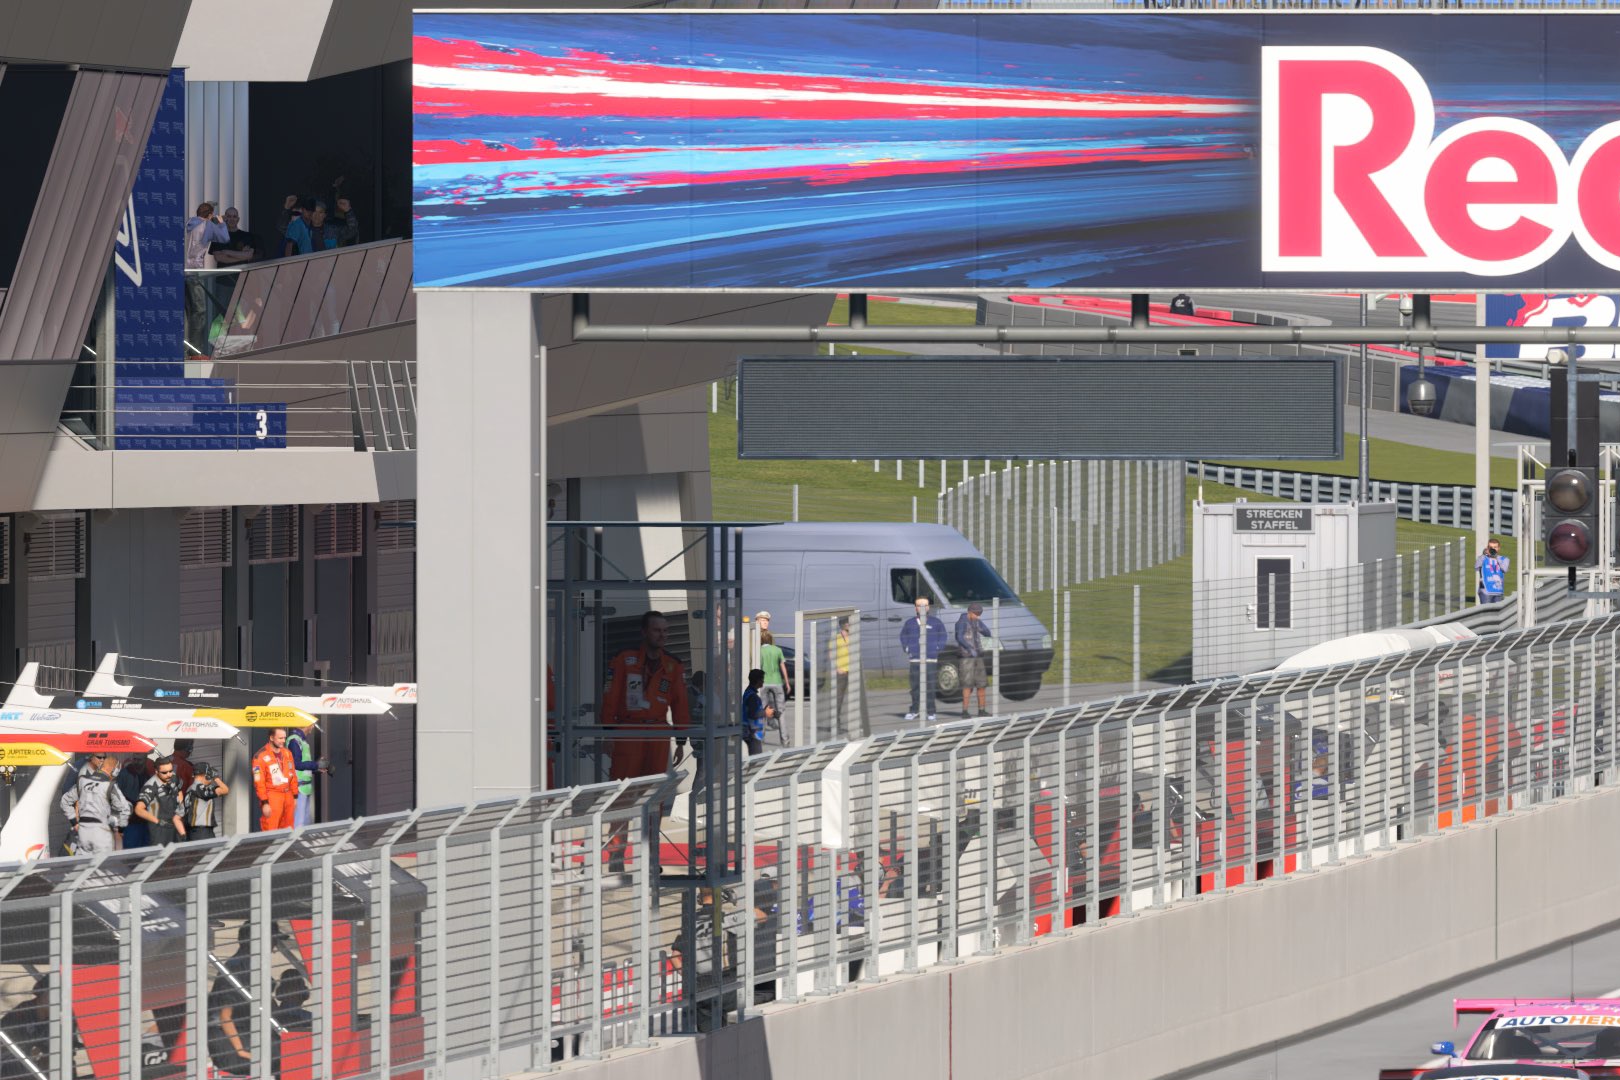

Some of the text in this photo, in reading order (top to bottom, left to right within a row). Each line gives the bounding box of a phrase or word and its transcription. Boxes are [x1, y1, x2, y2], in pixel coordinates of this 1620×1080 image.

[255, 409, 268, 440] 3
[1246, 509, 1303, 519] STRECKEN
[1250, 520, 1298, 530] STAFFEL
